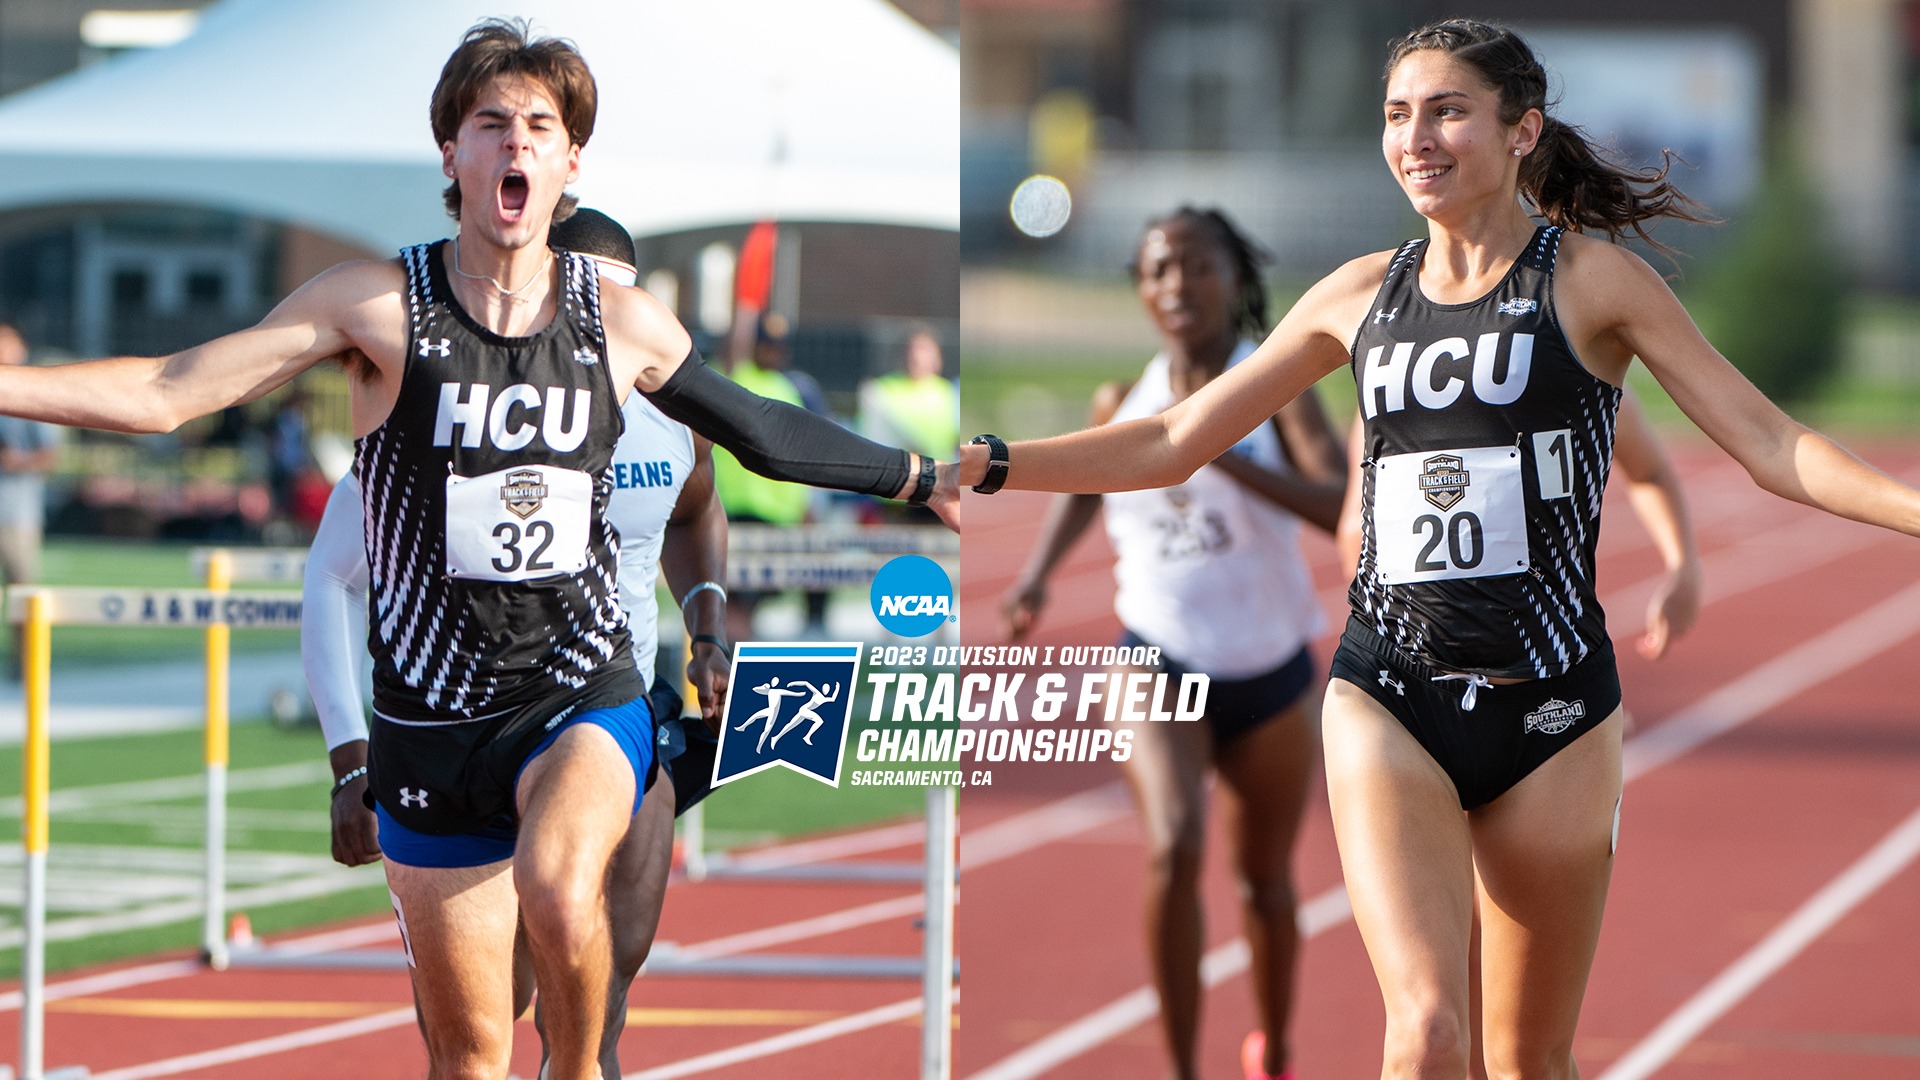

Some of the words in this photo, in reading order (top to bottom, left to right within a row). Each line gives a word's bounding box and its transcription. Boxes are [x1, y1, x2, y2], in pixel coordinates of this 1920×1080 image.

[1363, 332, 1535, 421] HCU
[433, 382, 592, 453] HCU
[613, 461, 673, 489] EANS
[1549, 434, 1570, 494] 1
[491, 521, 555, 573] 32
[1412, 511, 1485, 573] 20
[1527, 702, 1582, 729] SOUTHLAND
